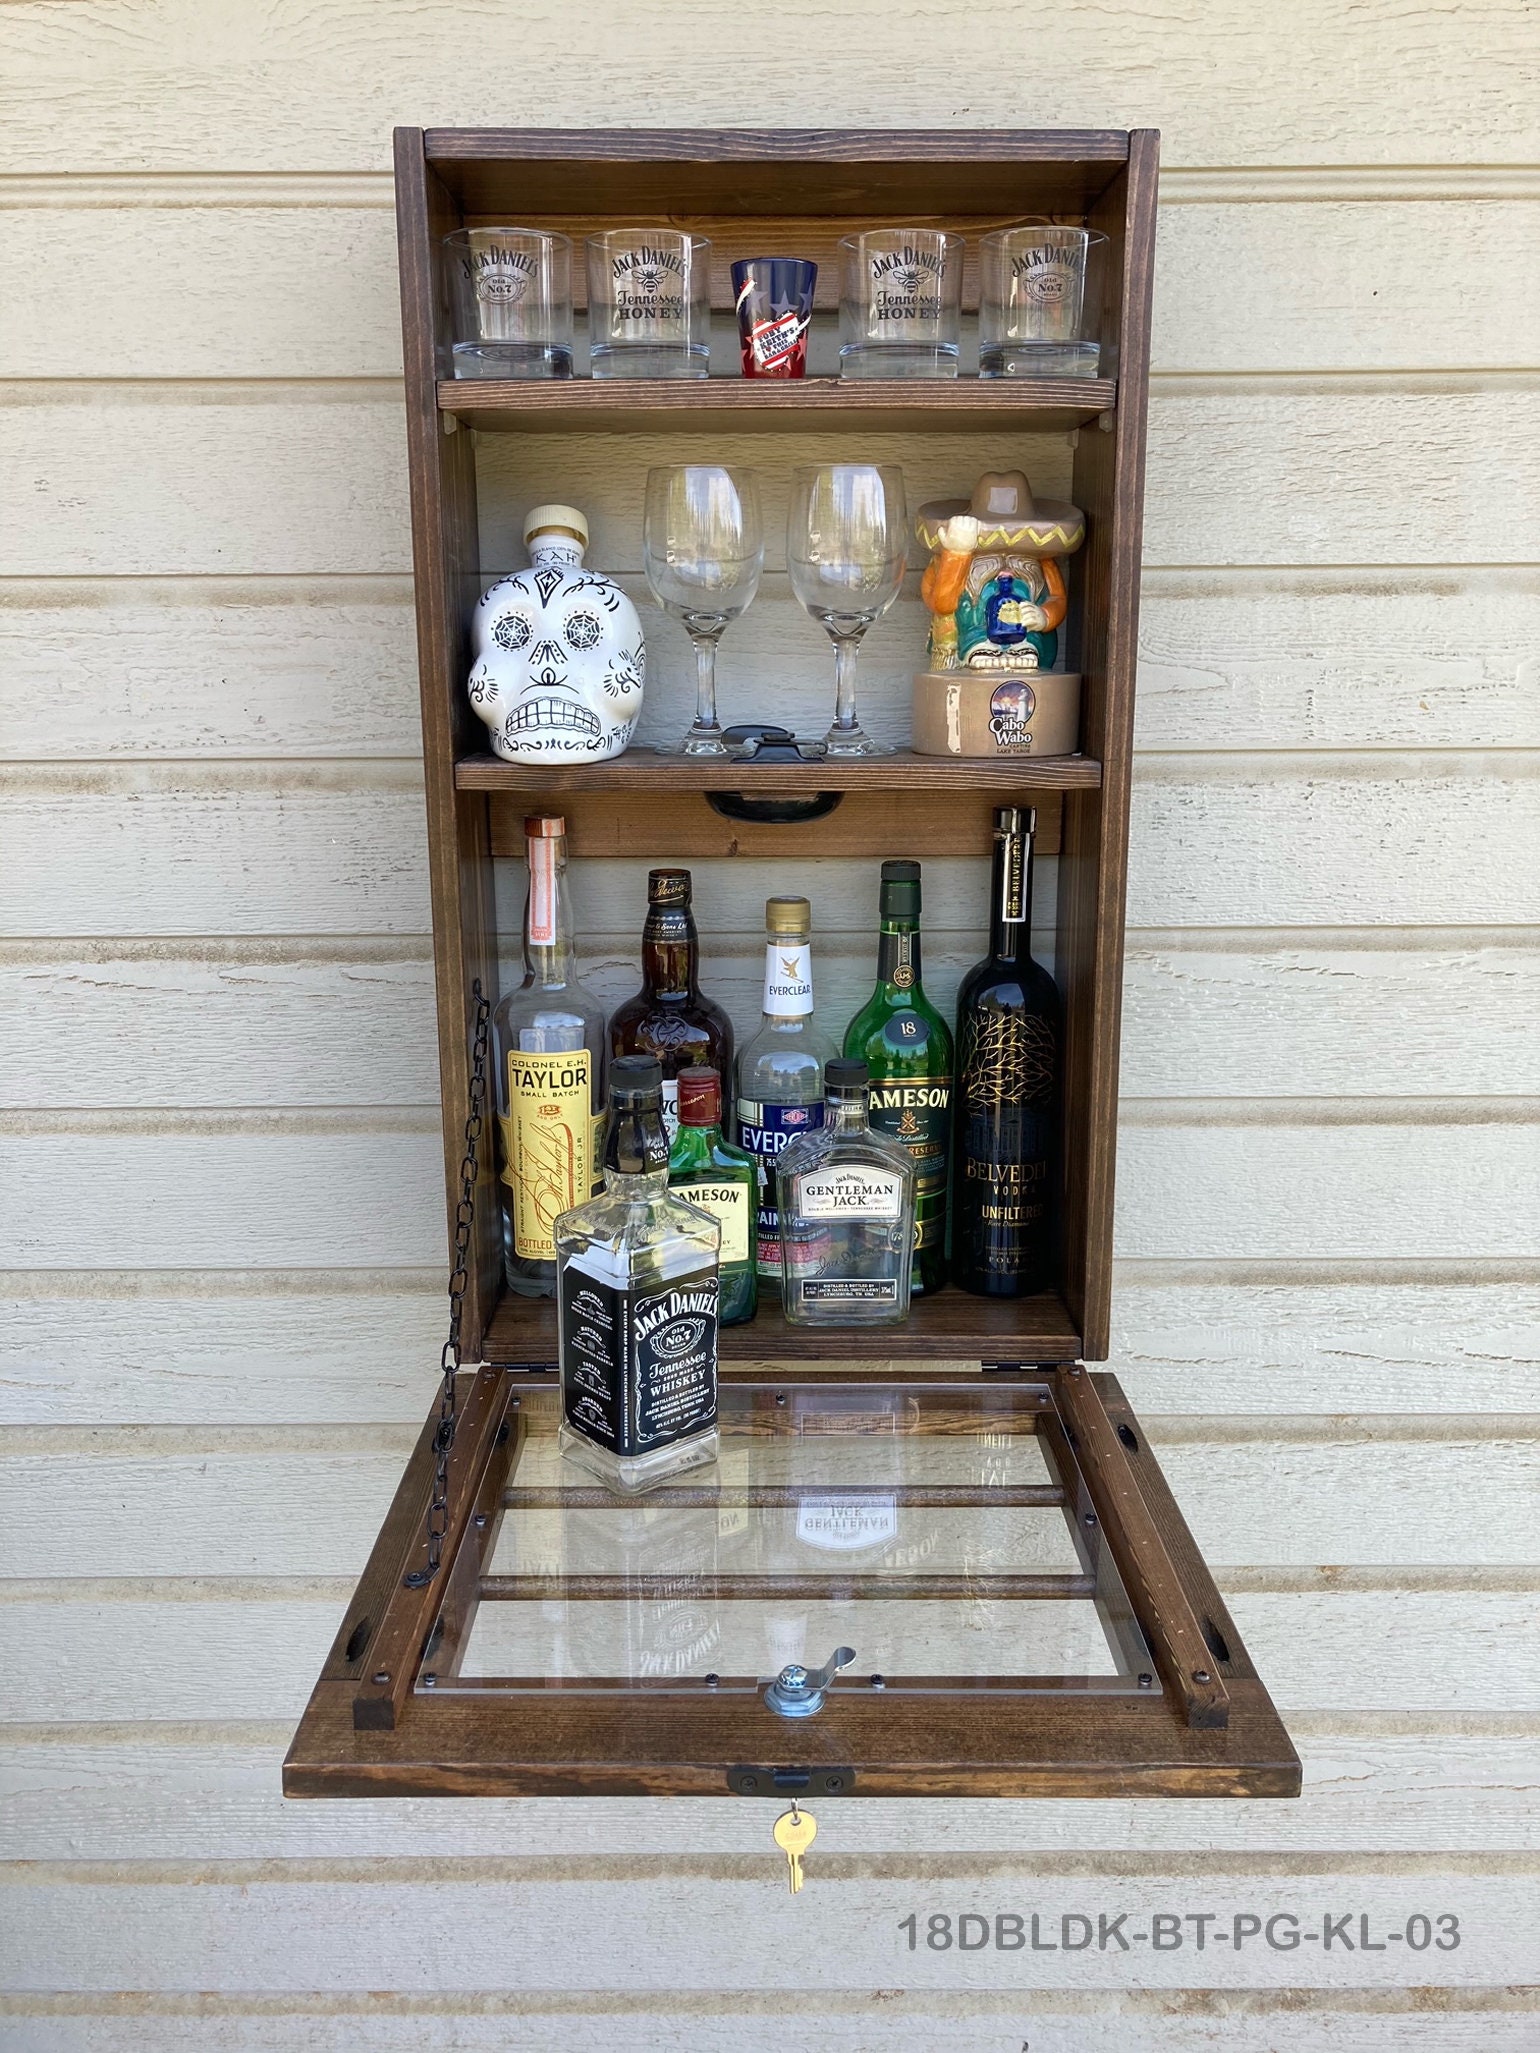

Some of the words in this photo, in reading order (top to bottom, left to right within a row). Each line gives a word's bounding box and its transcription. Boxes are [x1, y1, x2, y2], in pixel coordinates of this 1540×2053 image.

[462, 250, 490, 279] JACK
[490, 244, 538, 278] DANIEL'S
[612, 252, 640, 278] JACK
[873, 252, 902, 279] JACK
[1011, 249, 1043, 277] JACK
[618, 290, 683, 306] Tennessee
[878, 290, 942, 306] Tennessee
[619, 307, 682, 319] HONEY
[878, 308, 941, 320] HONEY
[536, 551, 575, 564] KAH
[989, 717, 1025, 733] Cabo
[995, 730, 1032, 746] Wabo
[769, 985, 811, 996] EVERCLEAR
[900, 1021, 916, 1035] 18
[512, 1059, 563, 1068] COLONEL
[512, 1068, 587, 1089] TAYLOR
[552, 1090, 580, 1098] BATCH
[869, 1088, 949, 1110] AMESON
[678, 1188, 740, 1203] AMESON
[806, 1185, 894, 1196] GENTLEMAN
[833, 1196, 867, 1208] JACK
[519, 1238, 552, 1249] BOTTLED
[633, 1302, 671, 1341] JACK
[670, 1291, 719, 1318] DANIEL'S
[665, 1329, 692, 1347] No.7
[671, 1325, 685, 1335] Old
[649, 1351, 707, 1379] Tennessee
[650, 1369, 706, 1397] WHISKEY
